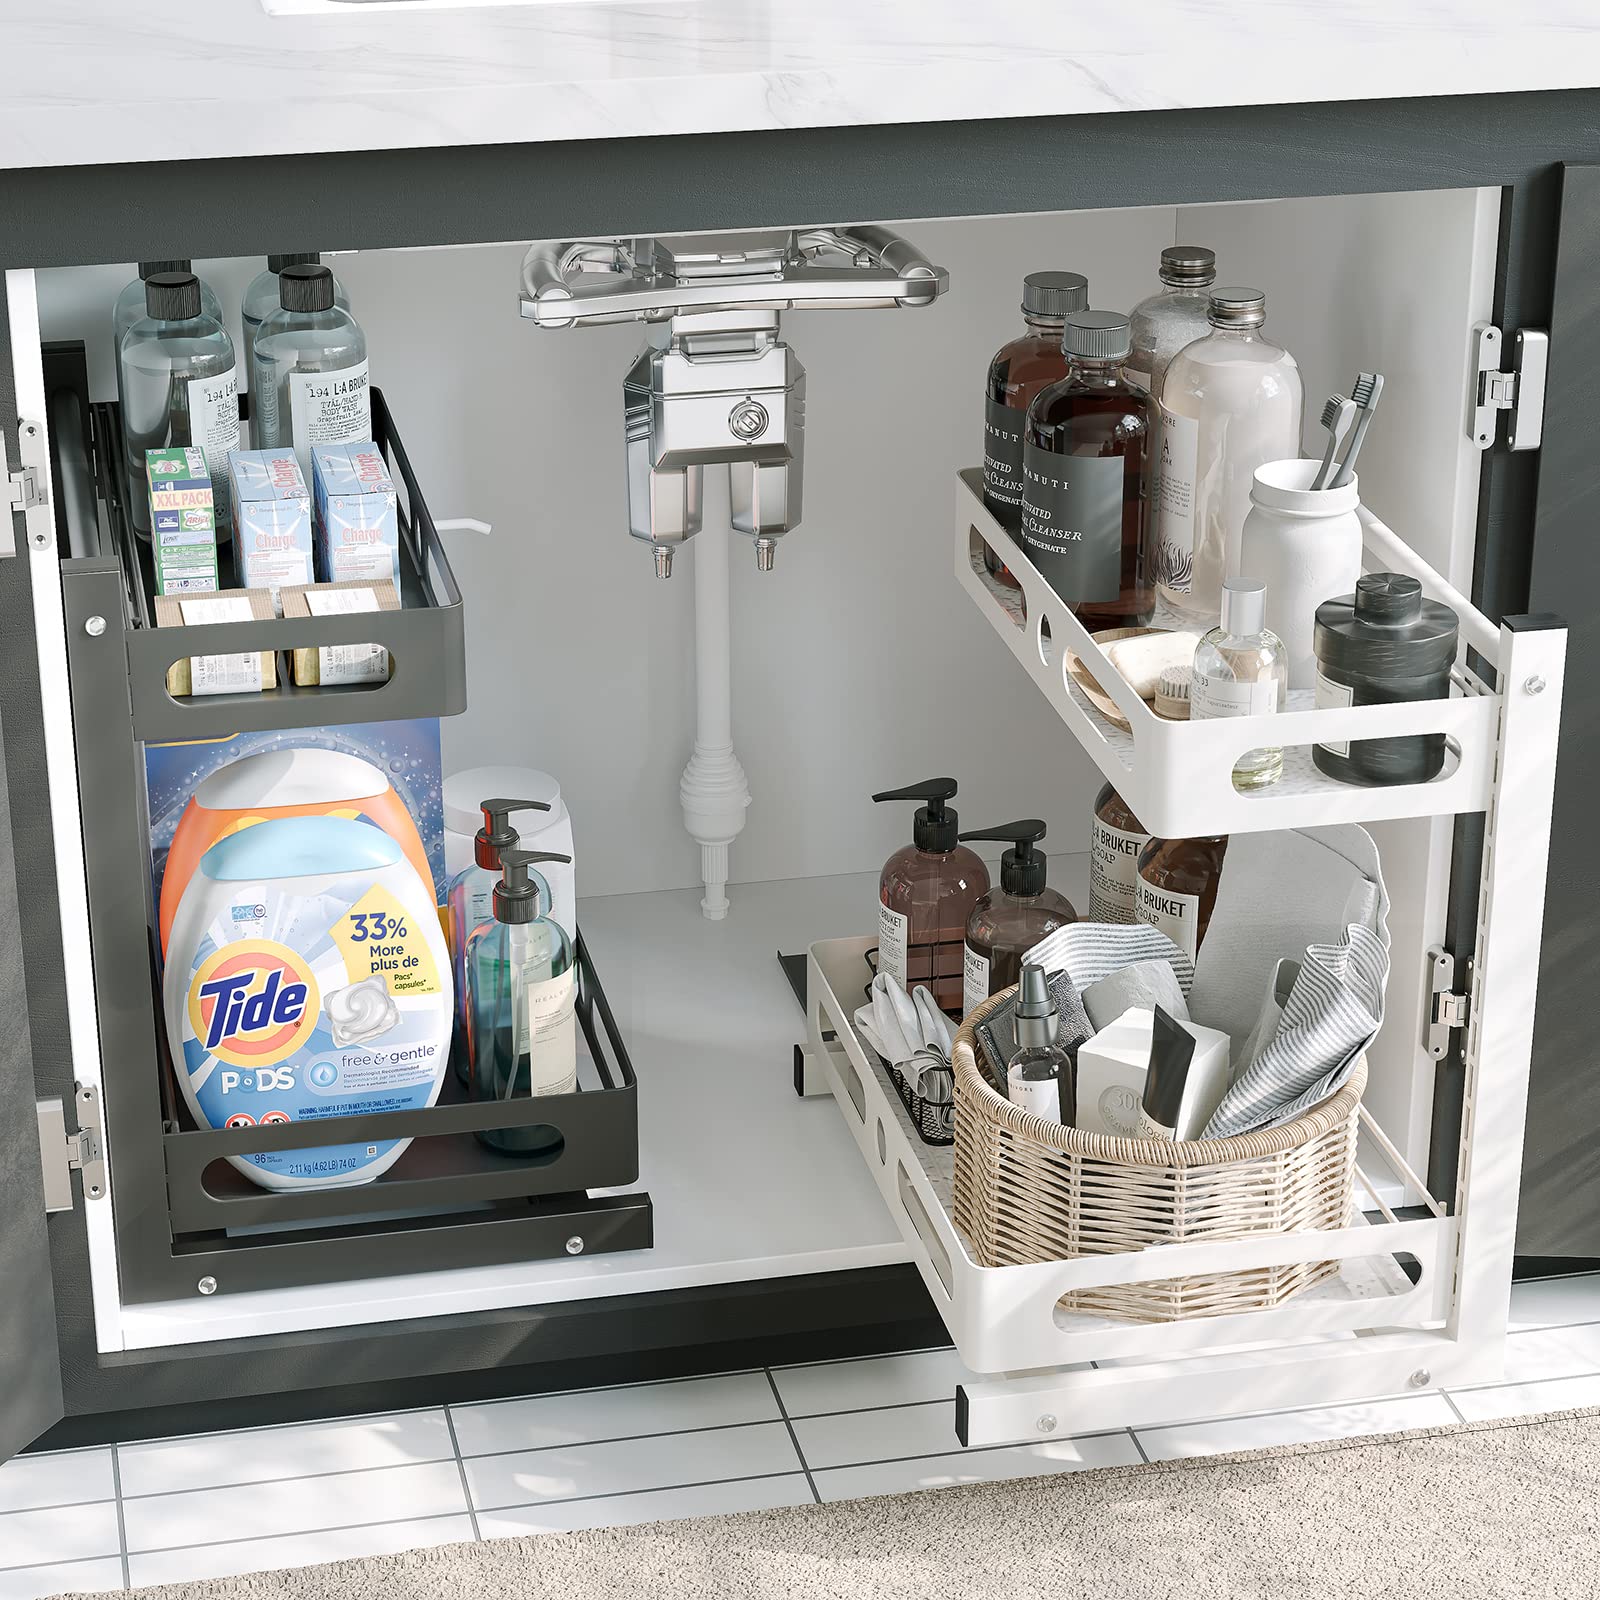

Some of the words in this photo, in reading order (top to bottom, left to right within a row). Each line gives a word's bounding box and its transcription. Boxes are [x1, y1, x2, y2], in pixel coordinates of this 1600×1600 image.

[207, 390, 223, 402] 194
[309, 387, 329, 398] 194
[334, 381, 347, 396] L:A
[321, 406, 341, 417] BODY
[271, 458, 297, 488] Charge
[356, 453, 383, 482] Charge
[990, 471, 1024, 492] CLEANS
[156, 493, 180, 507] XXL
[181, 490, 212, 506] PACK
[990, 489, 1024, 506] OXYGENAT
[342, 527, 383, 544] Charge
[1029, 517, 1083, 542] CLEANSER
[255, 533, 297, 549] Charge
[1027, 536, 1068, 555] OXYGENATE
[1101, 829, 1142, 857] BRUKET
[1144, 889, 1186, 918] BRUKET
[350, 912, 407, 942] 33%
[370, 945, 404, 957] More
[371, 958, 399, 974] plus
[402, 955, 419, 968] de
[199, 970, 308, 1050] Tide
[342, 1054, 371, 1067] free
[374, 1052, 388, 1065] &
[390, 1045, 435, 1064] gentle
[343, 1070, 381, 1079] Dermatologist
[382, 1064, 420, 1075] Recommended
[255, 1154, 267, 1164] 96
[290, 1164, 303, 1174] 2.11
[304, 1163, 312, 1174] kg
[312, 1161, 327, 1173] (4.62
[328, 1160, 339, 1171] LB)
[339, 1159, 347, 1169] 74
[348, 1158, 357, 1168] OZ
